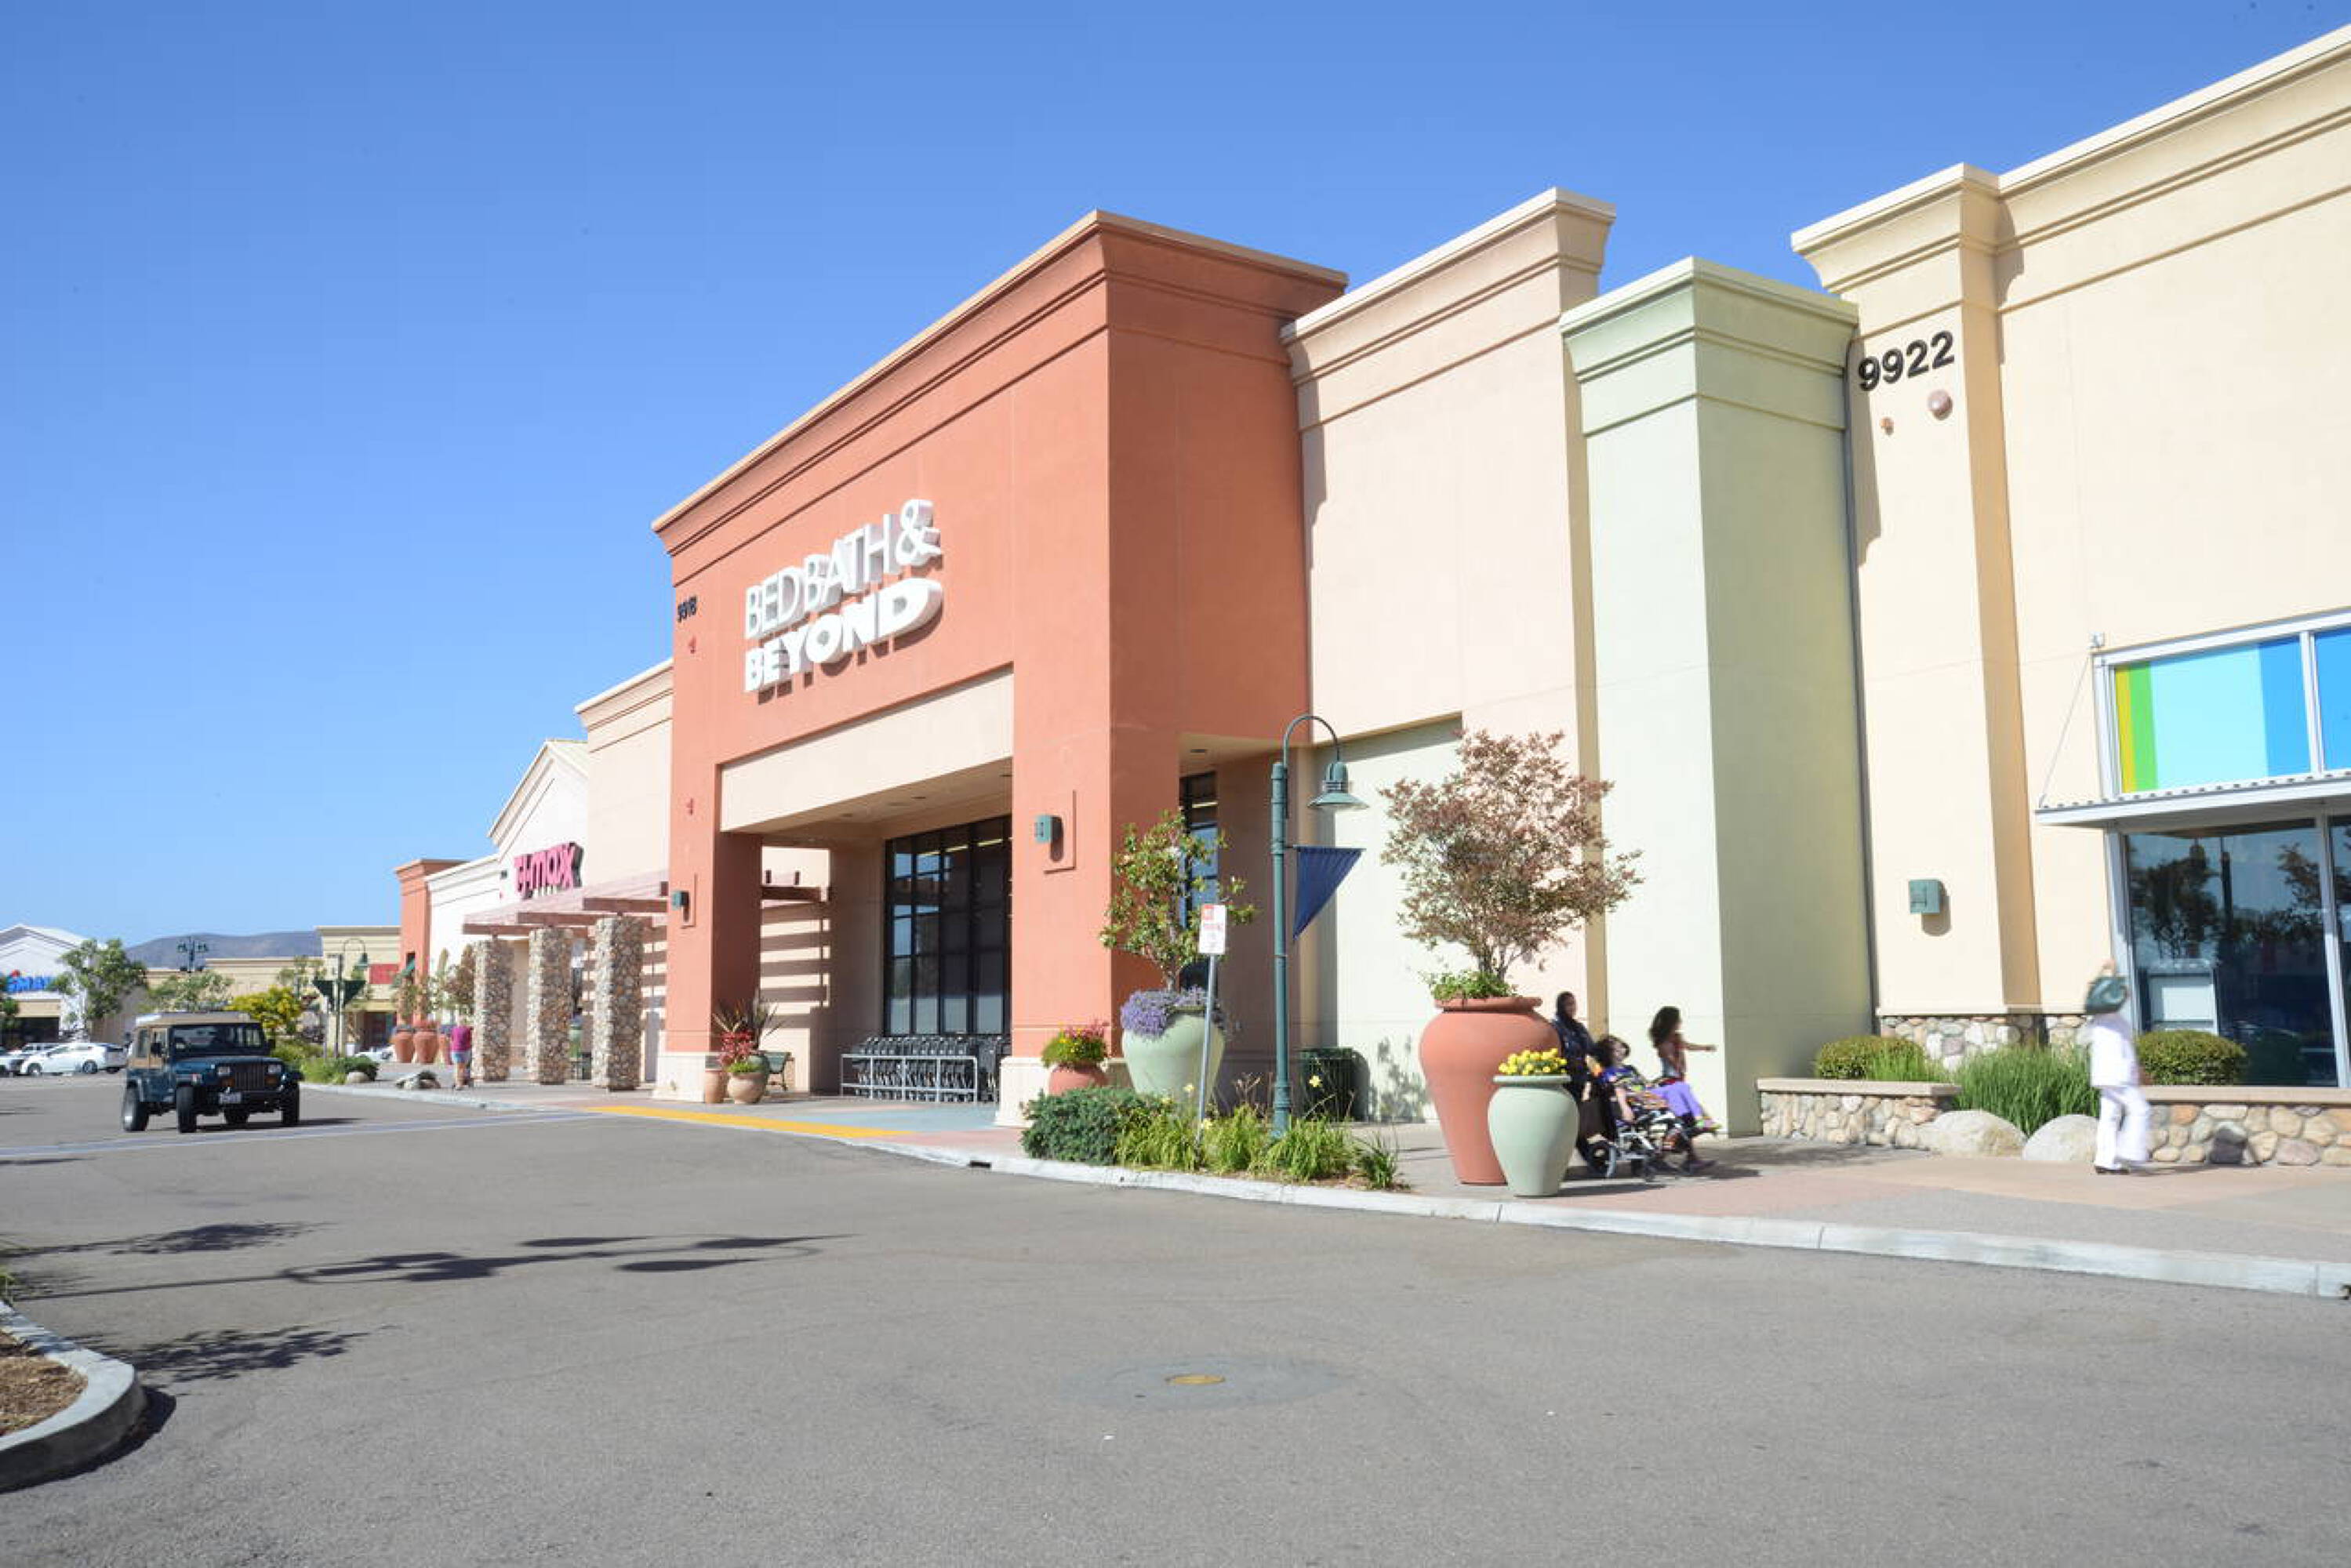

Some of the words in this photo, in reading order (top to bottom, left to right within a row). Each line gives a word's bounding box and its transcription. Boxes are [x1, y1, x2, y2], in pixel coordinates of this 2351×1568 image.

[1859, 330, 1955, 391] 9922
[745, 565, 809, 640] BED
[803, 513, 903, 612] BATH
[896, 499, 943, 566] &
[745, 576, 943, 692] BEYOND
